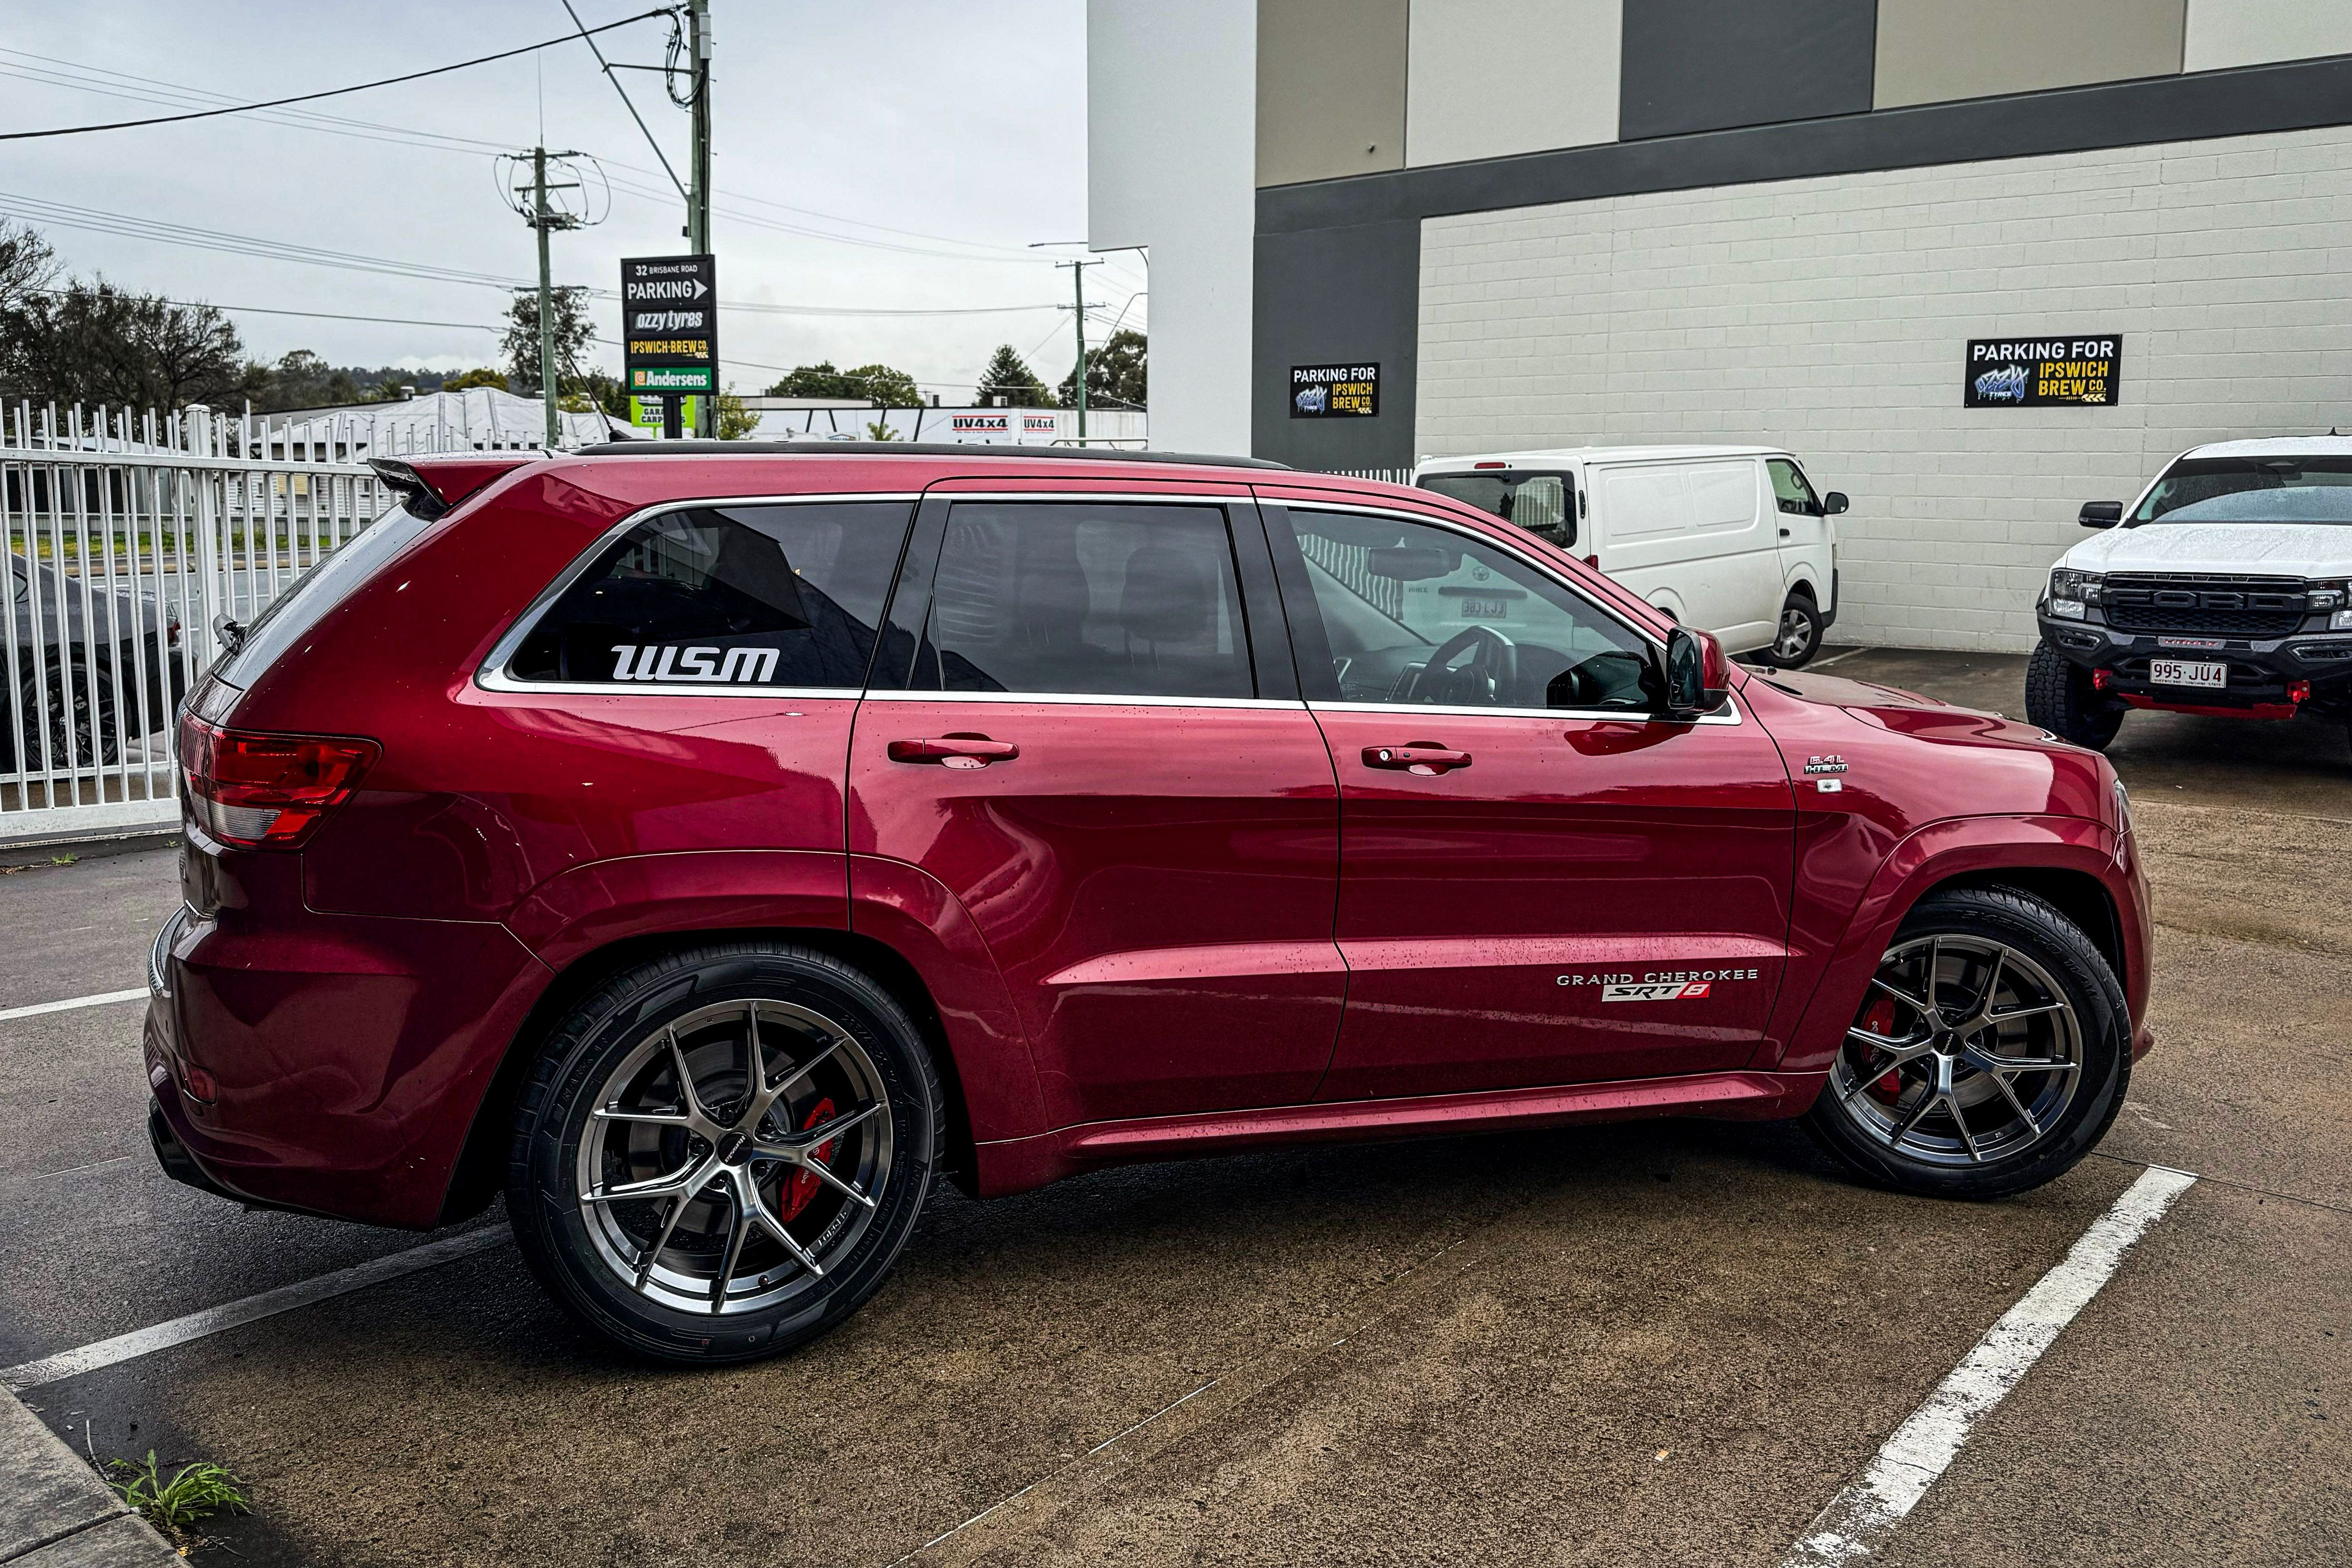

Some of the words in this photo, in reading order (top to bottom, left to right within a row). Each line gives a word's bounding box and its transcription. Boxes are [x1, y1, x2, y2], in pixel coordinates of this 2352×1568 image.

[635, 265, 648, 276] 32
[627, 280, 693, 299] PARKING
[667, 310, 703, 331] tyres
[1973, 342, 2065, 361] PARKING
[2071, 341, 2114, 358] FOR
[1294, 368, 1347, 382] PARKING
[1351, 367, 1376, 380] FOR
[2039, 361, 2108, 378] IPSWICH
[646, 370, 707, 387] Andersens
[1332, 382, 1373, 396] IPSWICH
[2038, 379, 2086, 396] BREW
[2089, 379, 2106, 391] CO.
[1332, 396, 1360, 409] BREW
[953, 418, 1008, 428] UV4x4
[1024, 419, 1054, 429] UV4x4
[1556, 973, 1634, 986] GRAND
[1644, 968, 1758, 983] CHEROKEE
